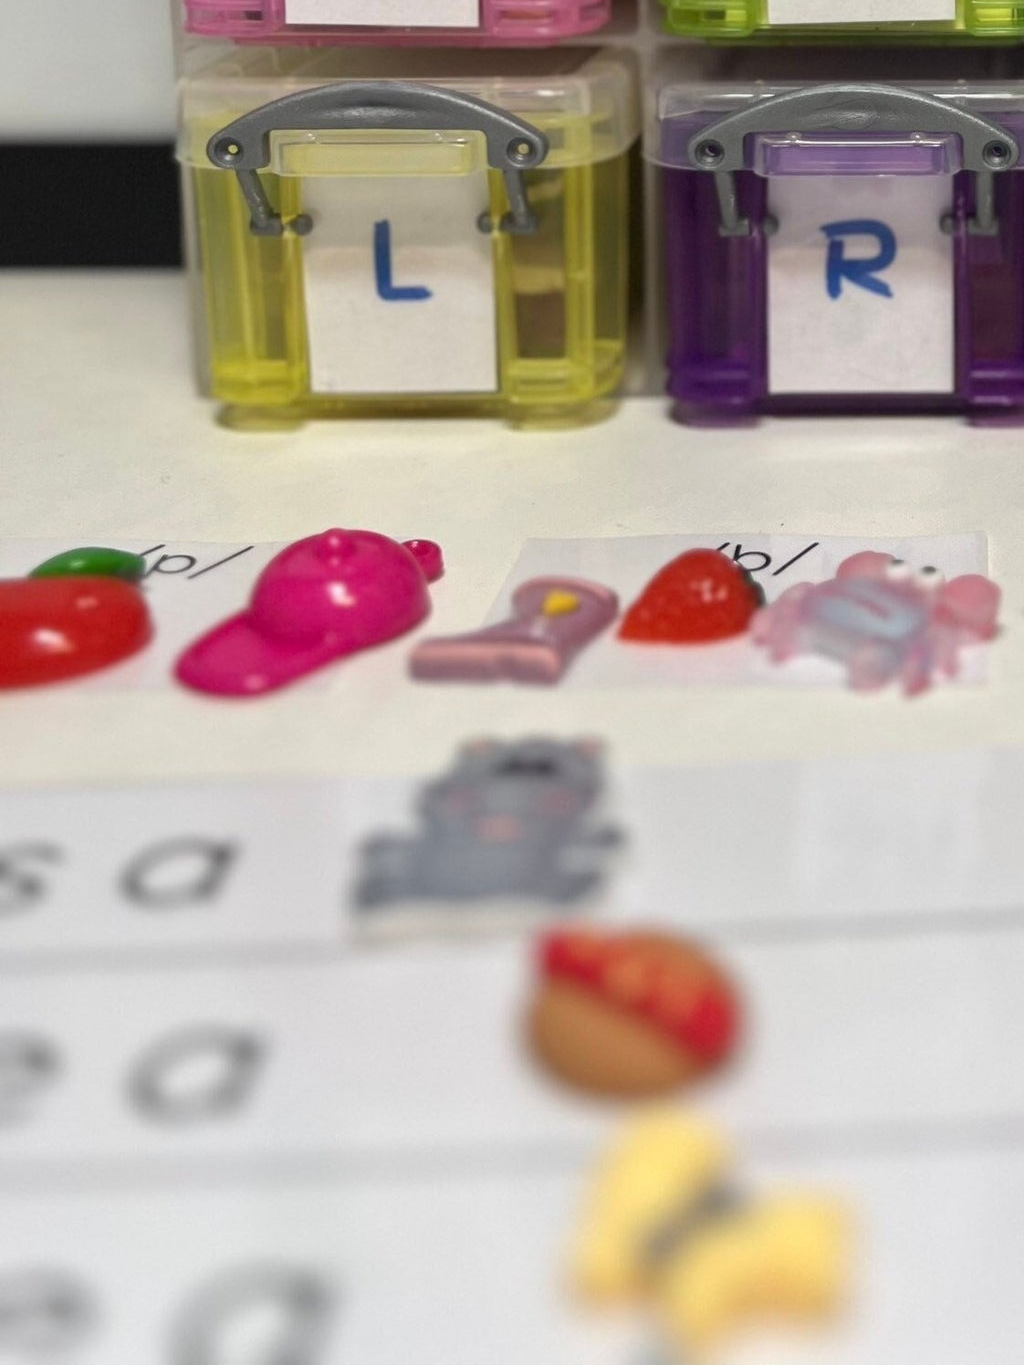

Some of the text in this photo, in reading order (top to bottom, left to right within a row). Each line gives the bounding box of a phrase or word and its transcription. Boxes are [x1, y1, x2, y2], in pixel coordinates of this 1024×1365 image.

[374, 219, 432, 302] L
[823, 220, 897, 300] R
[116, 834, 240, 912] a
